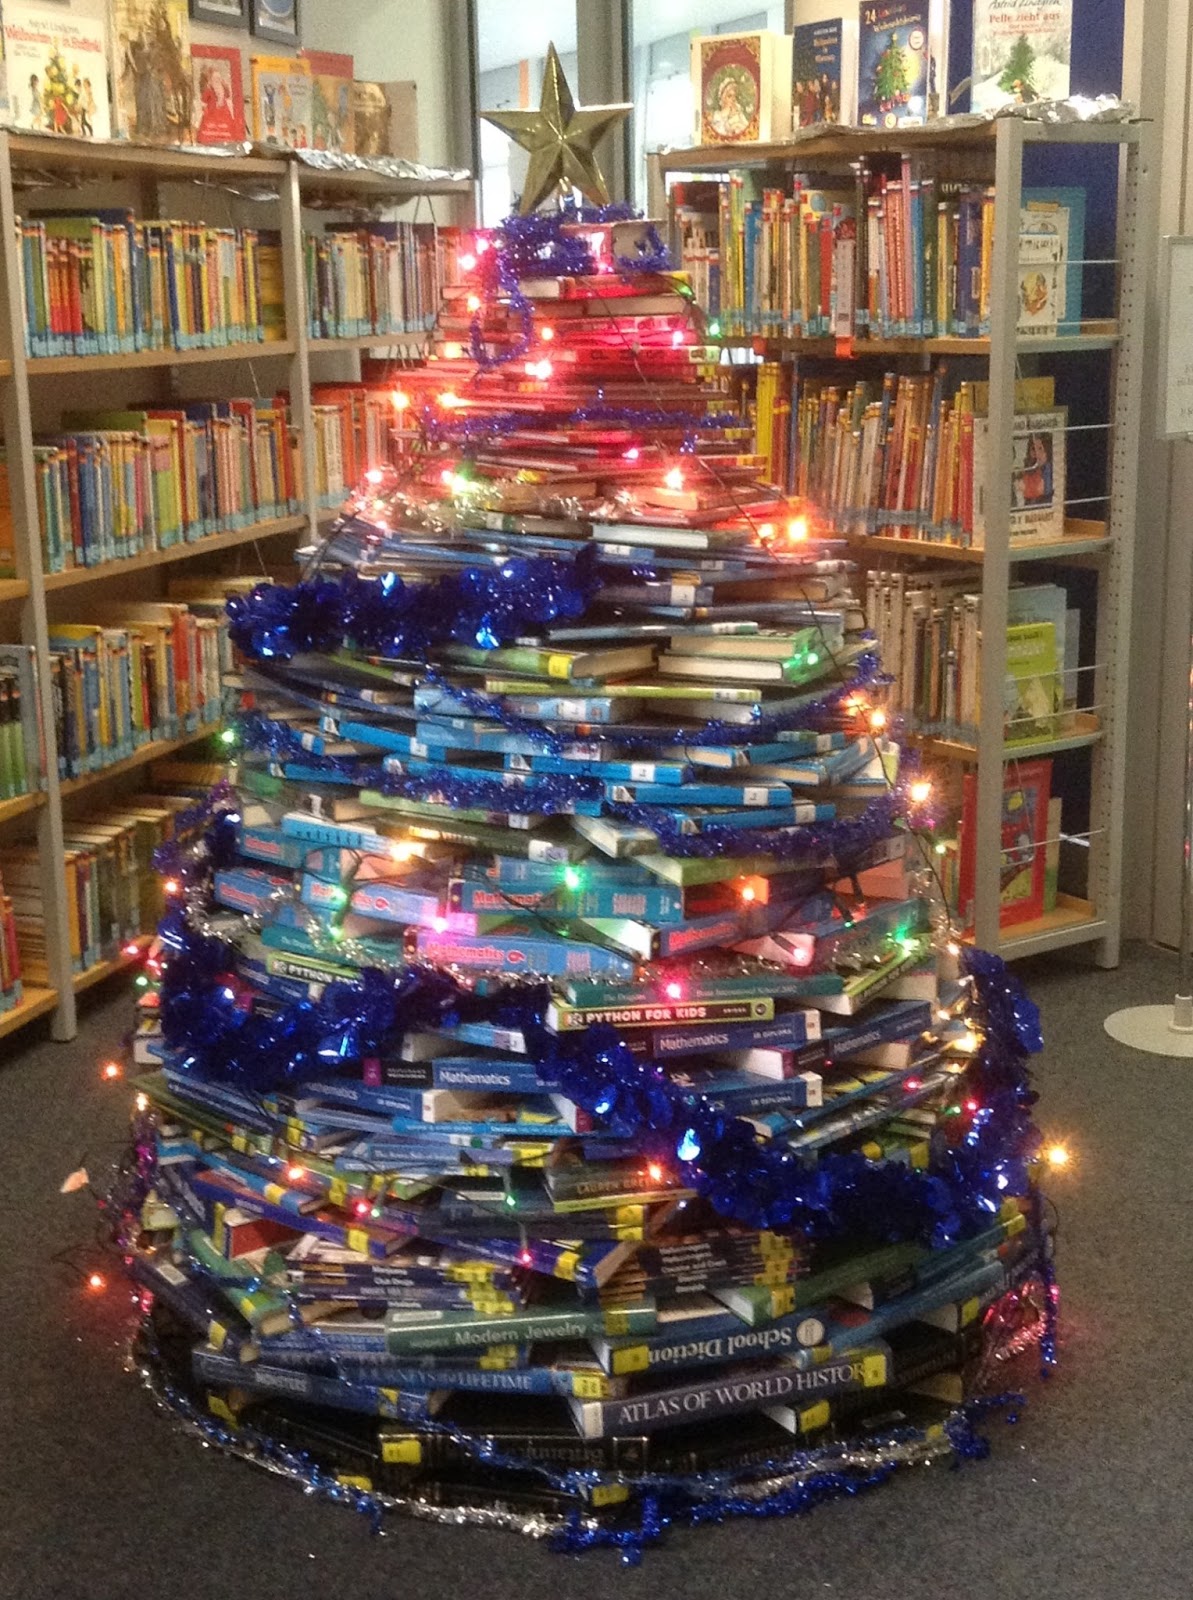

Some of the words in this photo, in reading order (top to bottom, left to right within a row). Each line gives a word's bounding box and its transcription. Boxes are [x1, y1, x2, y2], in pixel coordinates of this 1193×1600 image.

[988, 13, 1013, 23] Pelle
[1016, 12, 1041, 22] zieht
[1043, 12, 1060, 21] aus
[288, 964, 333, 984] PYTHON
[586, 1010, 641, 1024] PYTHON
[645, 1008, 671, 1022] FOR
[675, 1006, 708, 1019] KIDS
[659, 1031, 730, 1052] Mathematics
[439, 1069, 512, 1087] Mathematics
[304, 1082, 359, 1102] athematics
[455, 1326, 520, 1347] Modern
[524, 1320, 587, 1341] Jewelry
[728, 1326, 794, 1351] School
[648, 1338, 723, 1366] Diction
[620, 1400, 682, 1425] ATLAS
[682, 1391, 713, 1413] OF
[714, 1376, 794, 1406] WORLD
[796, 1362, 866, 1391] HISTOR
